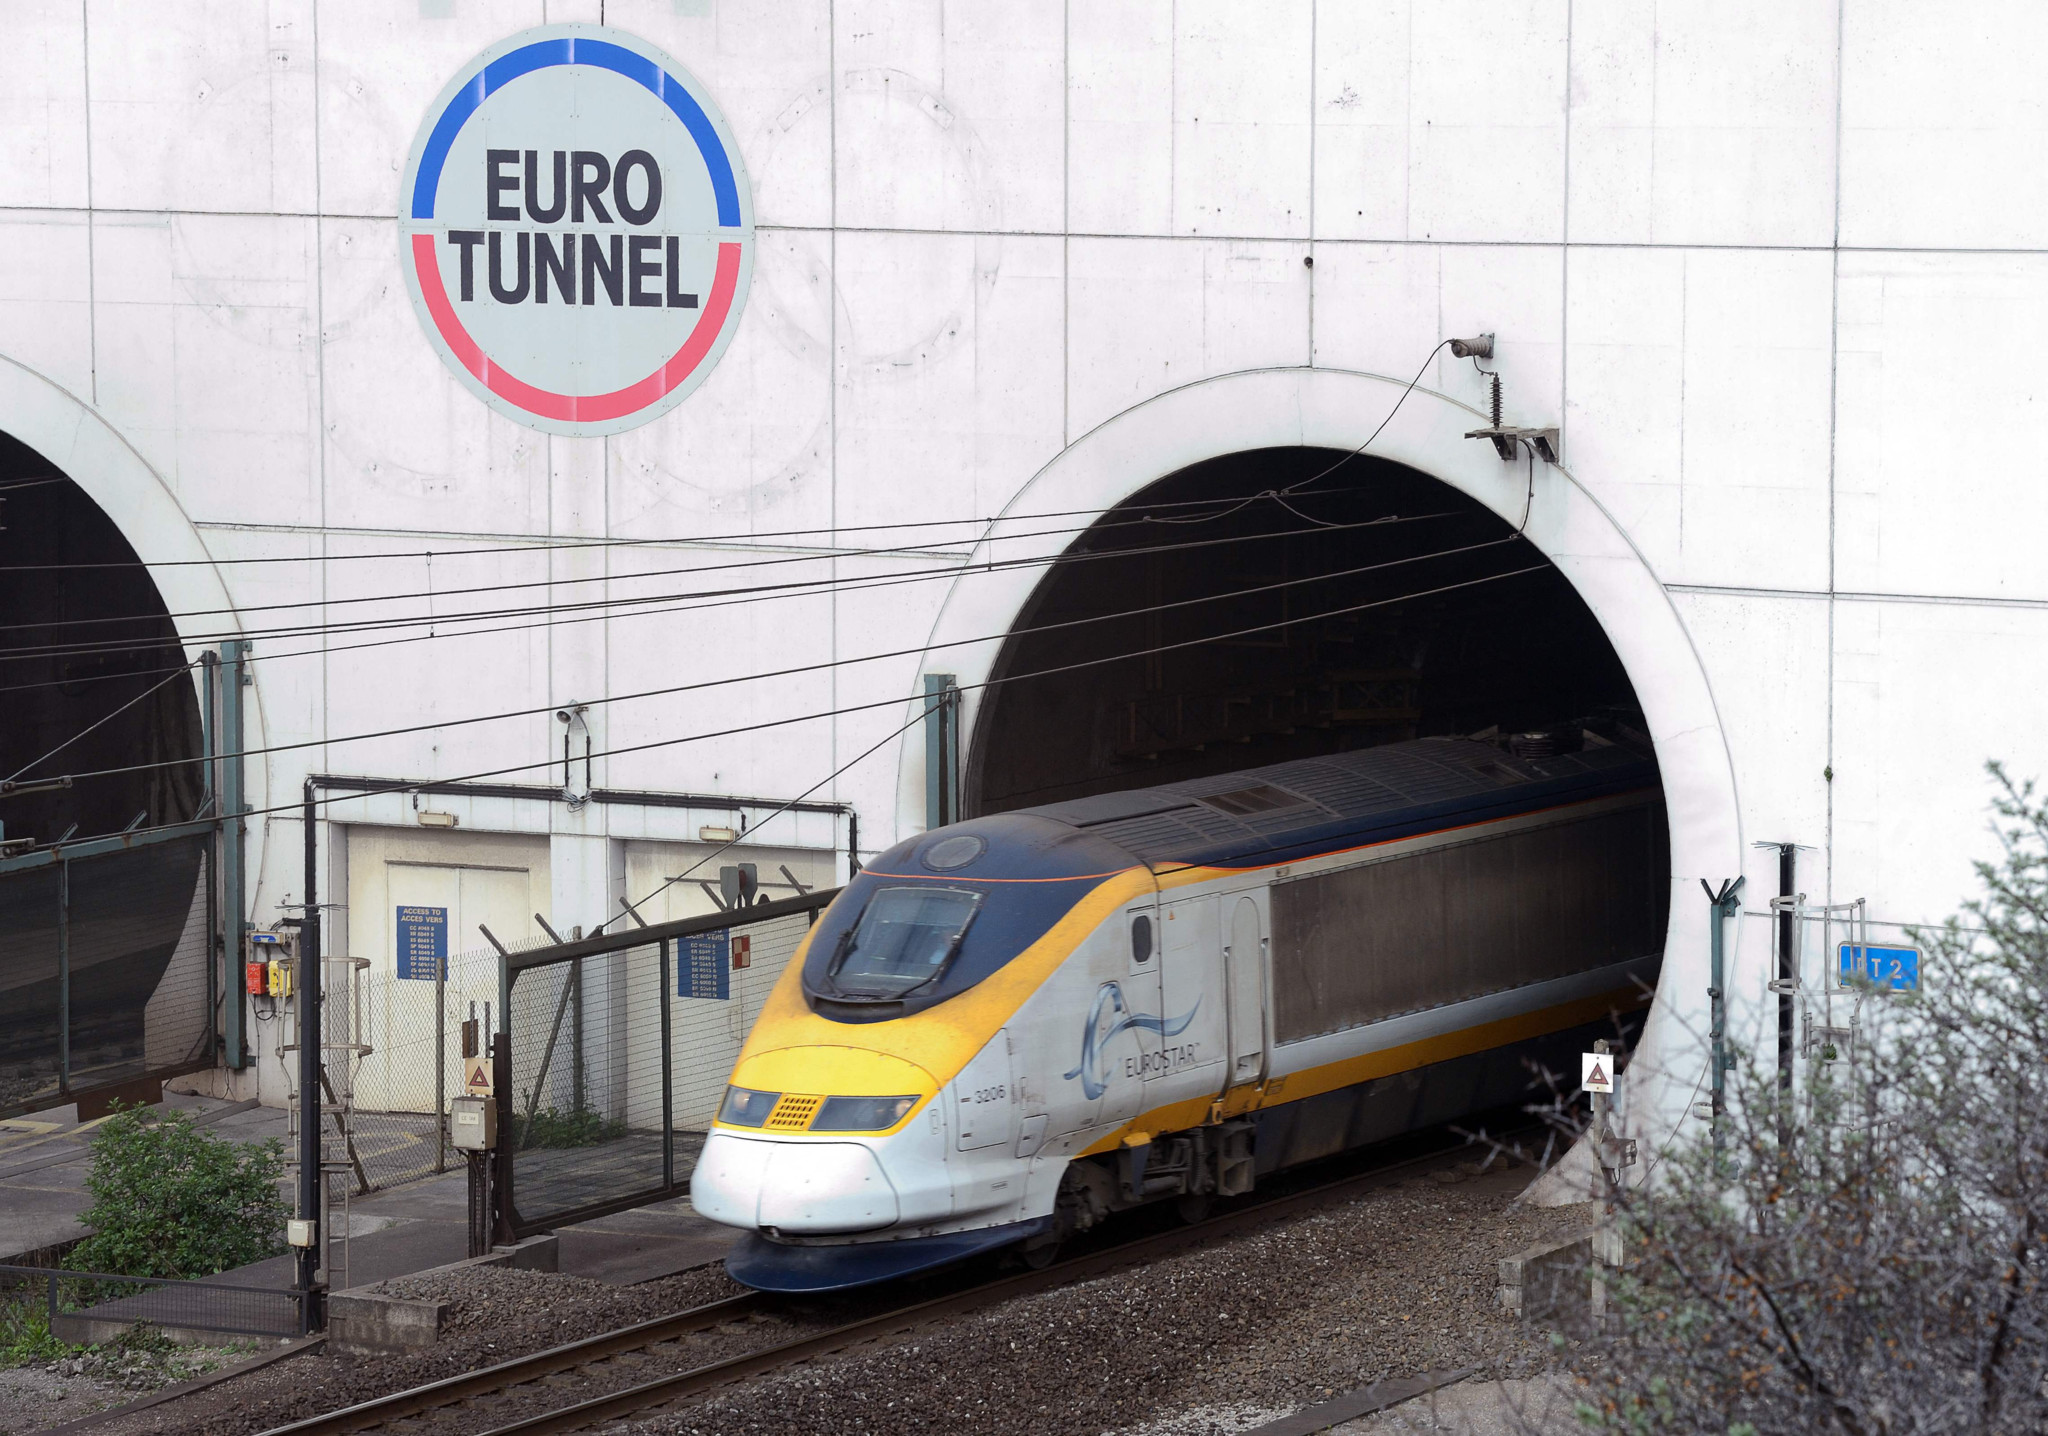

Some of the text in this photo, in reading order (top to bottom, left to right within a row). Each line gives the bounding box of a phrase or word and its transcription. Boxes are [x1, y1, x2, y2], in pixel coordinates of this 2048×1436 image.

[487, 149, 662, 225] EURO
[448, 230, 698, 308] TUNNEL
[1890, 959, 1902, 979] 2
[1126, 1044, 1195, 1078] EUROSTAR
[975, 1085, 1006, 1104] 3206
